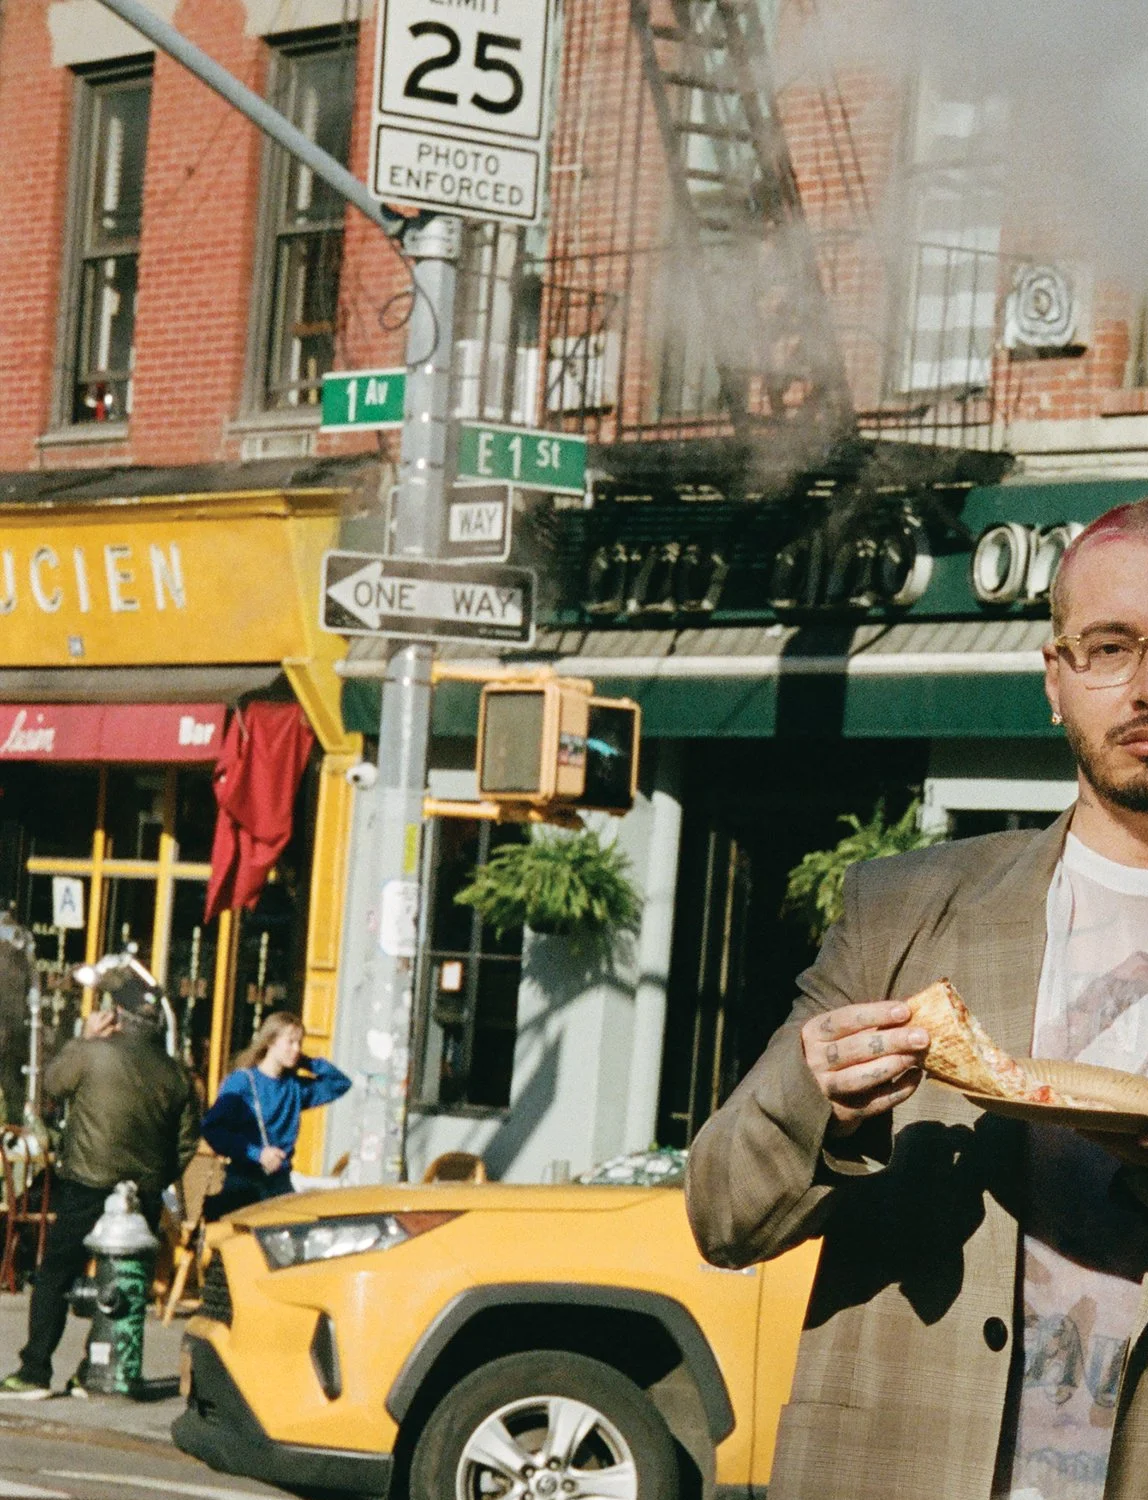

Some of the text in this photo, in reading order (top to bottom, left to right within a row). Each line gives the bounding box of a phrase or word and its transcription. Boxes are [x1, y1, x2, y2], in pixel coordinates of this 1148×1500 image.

[403, 21, 524, 115] 25
[418, 142, 499, 175] PHOTO
[389, 166, 523, 207] ENFORCED
[346, 378, 389, 422] 1 Av
[477, 432, 561, 478] E 1 St
[458, 507, 498, 536] WAY
[353, 580, 517, 619] ONE WAY
